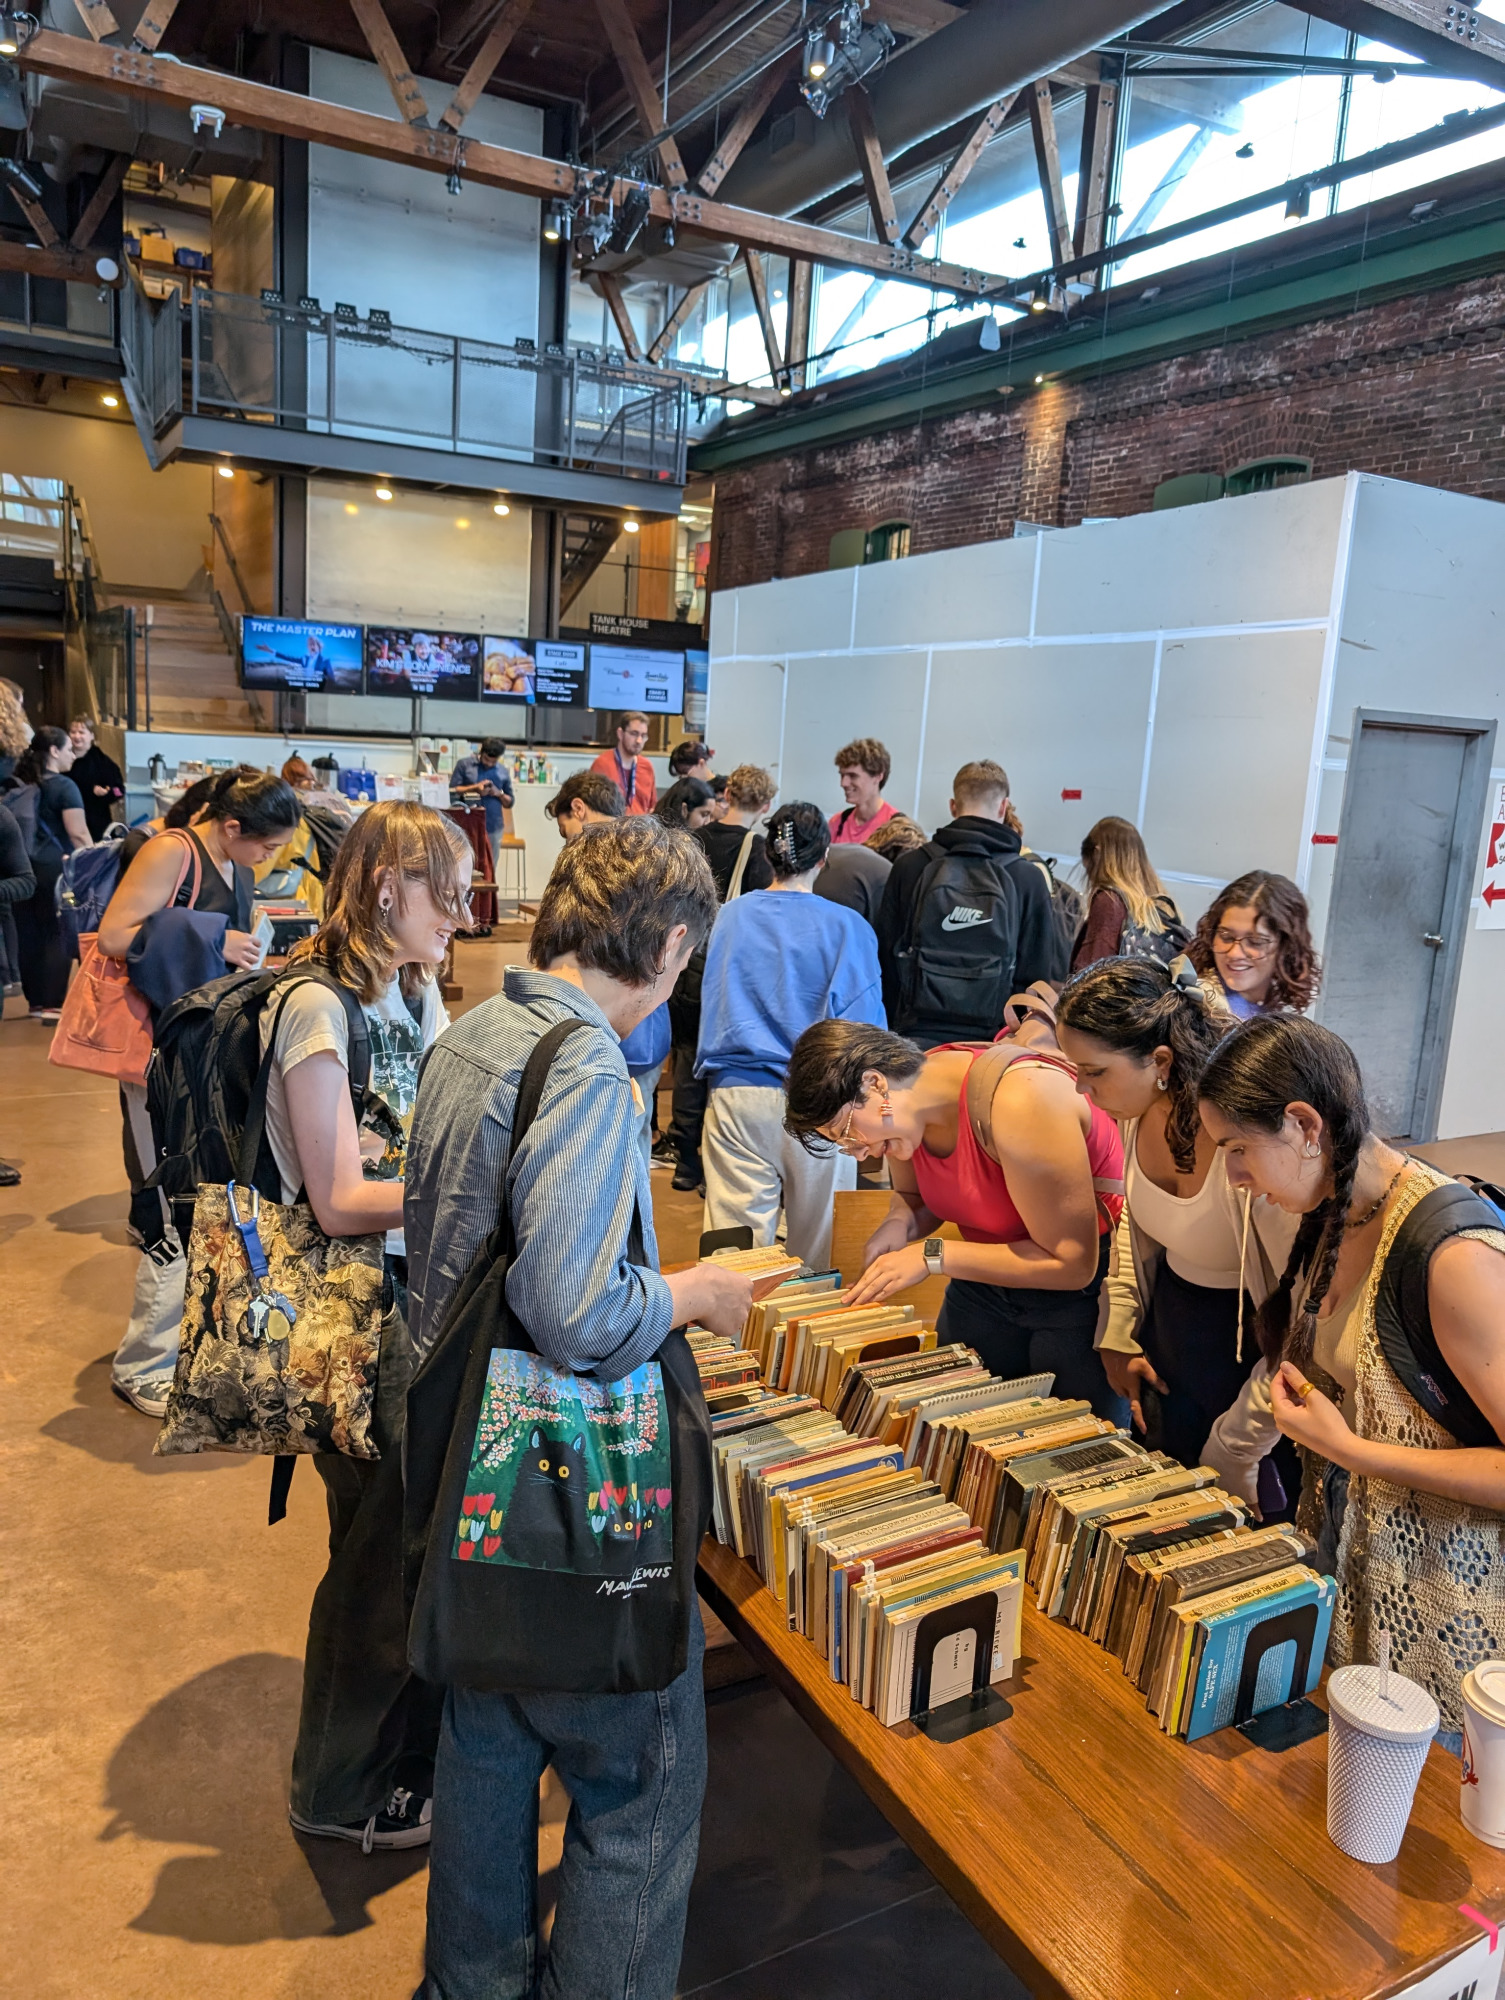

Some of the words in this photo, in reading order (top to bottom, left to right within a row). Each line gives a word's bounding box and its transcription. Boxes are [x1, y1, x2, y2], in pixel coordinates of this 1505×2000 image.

[252, 621, 274, 632] THE
[276, 624, 324, 636] MASTER
[325, 627, 356, 638] PLAN
[592, 615, 616, 626] TANK
[619, 618, 648, 629] HOUSE
[592, 624, 632, 636] THEATRE
[950, 906, 984, 922] NIKE
[1171, 1501, 1189, 1509] LEVIN
[632, 1566, 672, 1582] LEWIS
[1210, 1600, 1231, 1612] HENLEY
[1232, 1591, 1252, 1604] CRIMES
[1253, 1588, 1262, 1598] OF
[1262, 1584, 1272, 1595] THE
[1272, 1578, 1290, 1592] HEART
[1206, 1612, 1225, 1624] SAFE
[1225, 1608, 1238, 1618] SEX
